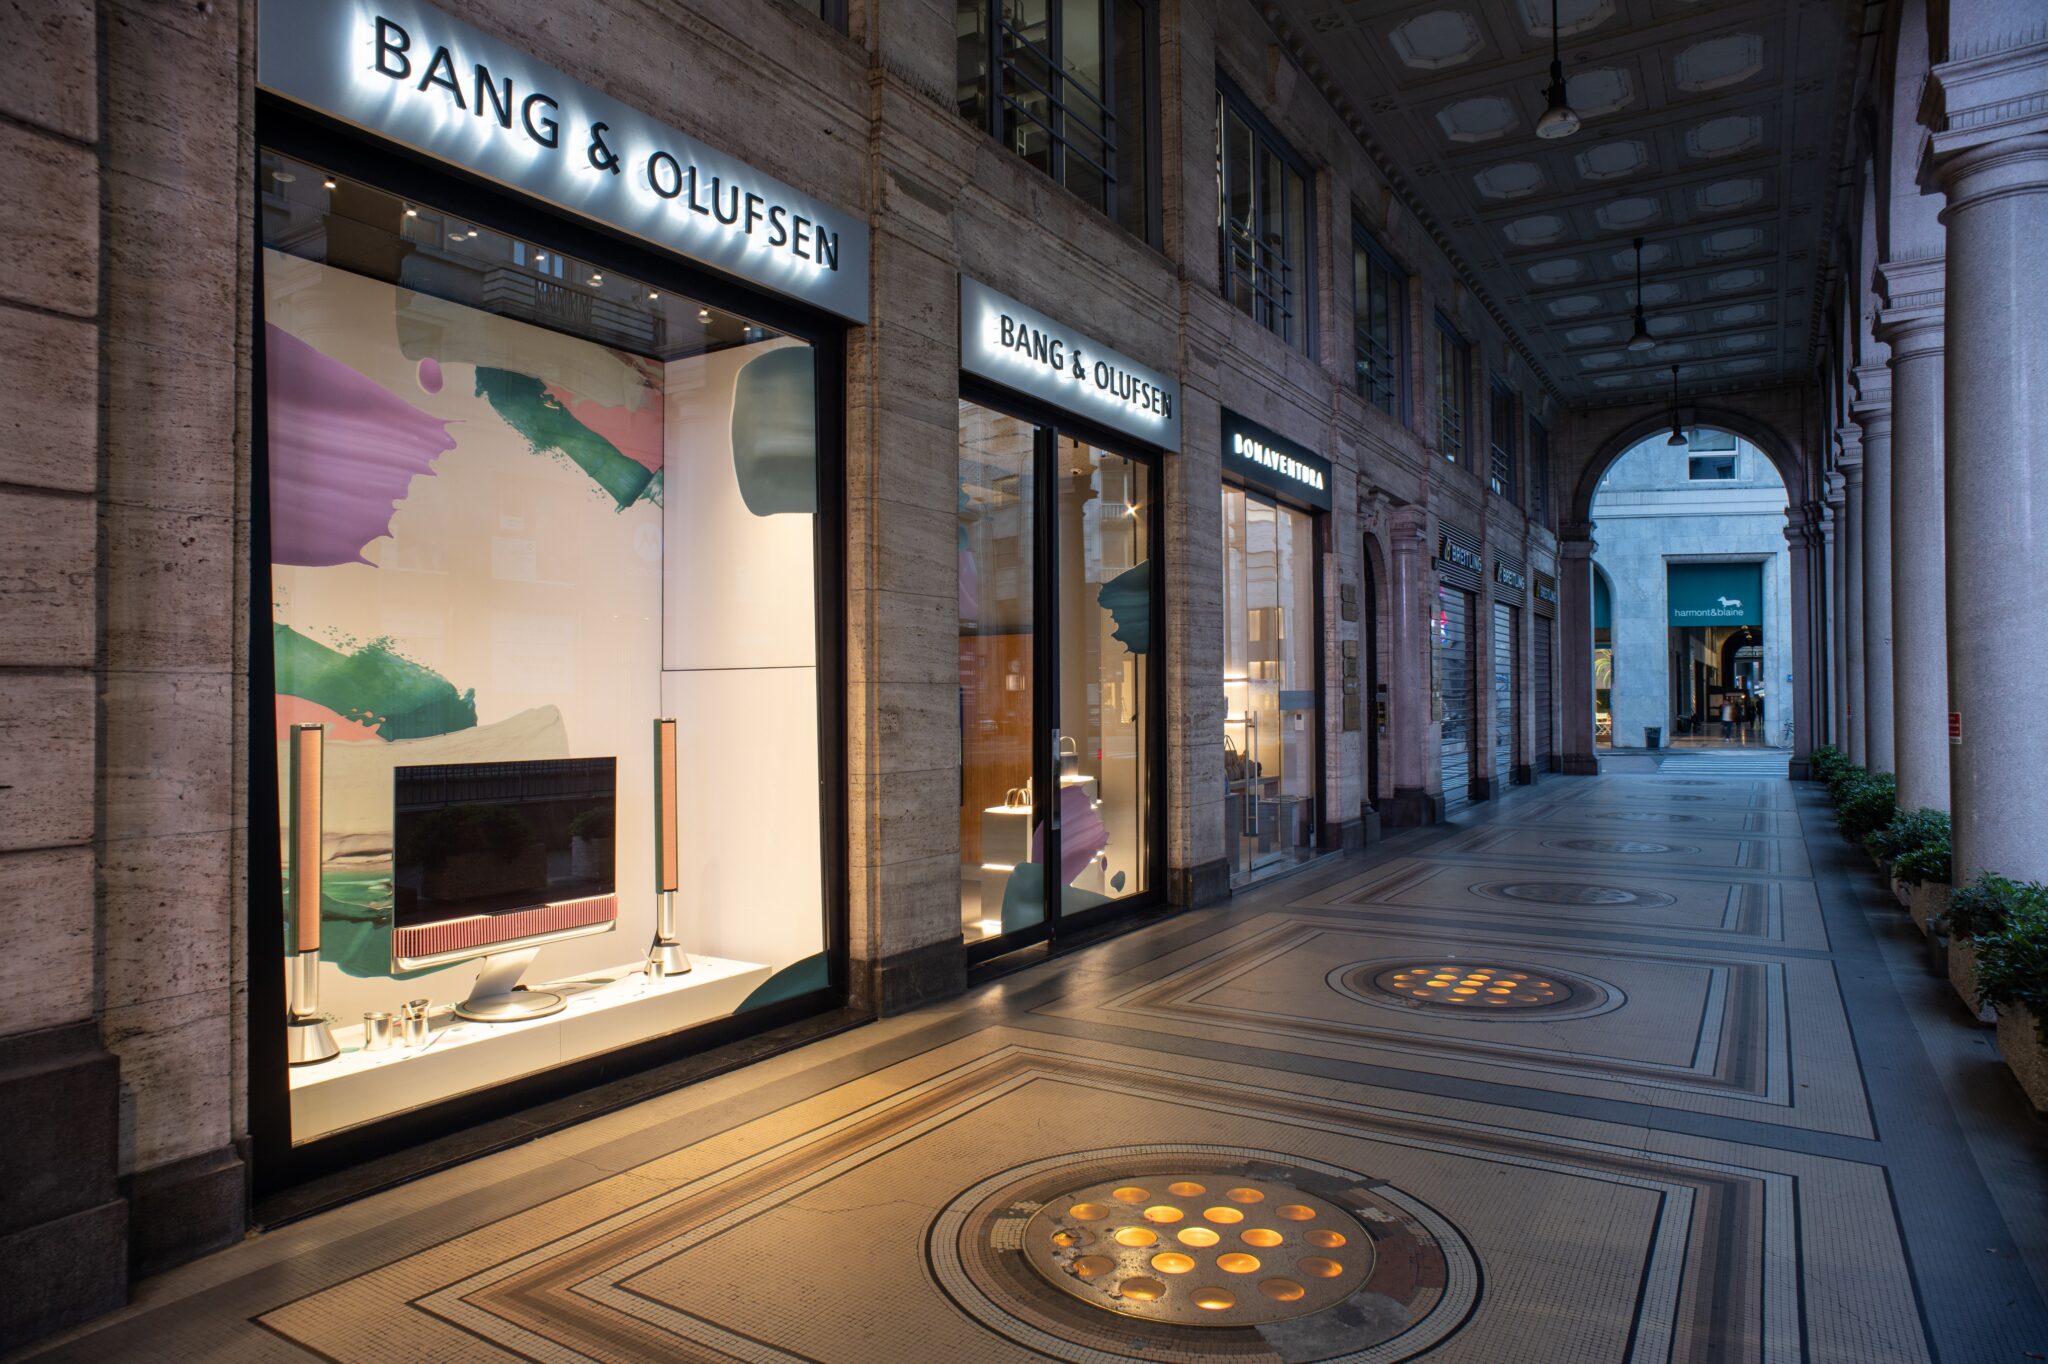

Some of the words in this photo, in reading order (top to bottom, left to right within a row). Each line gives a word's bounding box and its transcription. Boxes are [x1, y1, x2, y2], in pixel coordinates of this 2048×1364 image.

[374, 15, 559, 149] BANG
[587, 121, 621, 175] &
[647, 151, 839, 271] OLUFSEN
[1000, 314, 1064, 370] BANG
[1072, 350, 1086, 380] &
[1094, 361, 1172, 419] OLUFSEN
[1233, 433, 1324, 490] BONAVENTURA
[1674, 608, 1744, 617] harmont&blaine
